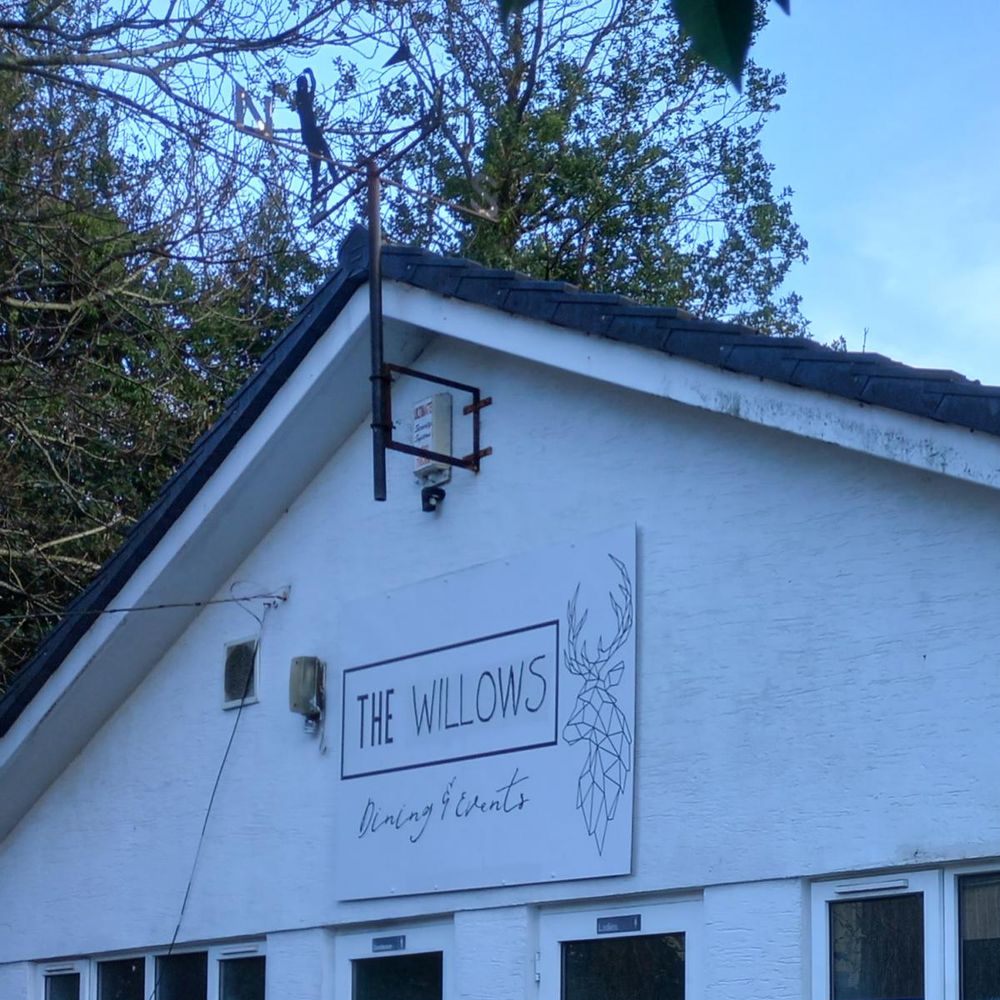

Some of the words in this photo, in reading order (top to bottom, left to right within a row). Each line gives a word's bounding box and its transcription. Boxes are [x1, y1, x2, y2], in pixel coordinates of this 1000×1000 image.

[357, 689, 394, 749] THE
[412, 655, 546, 736] WILLOWS
[358, 797, 434, 843] Dining
[455, 768, 530, 818] Events
